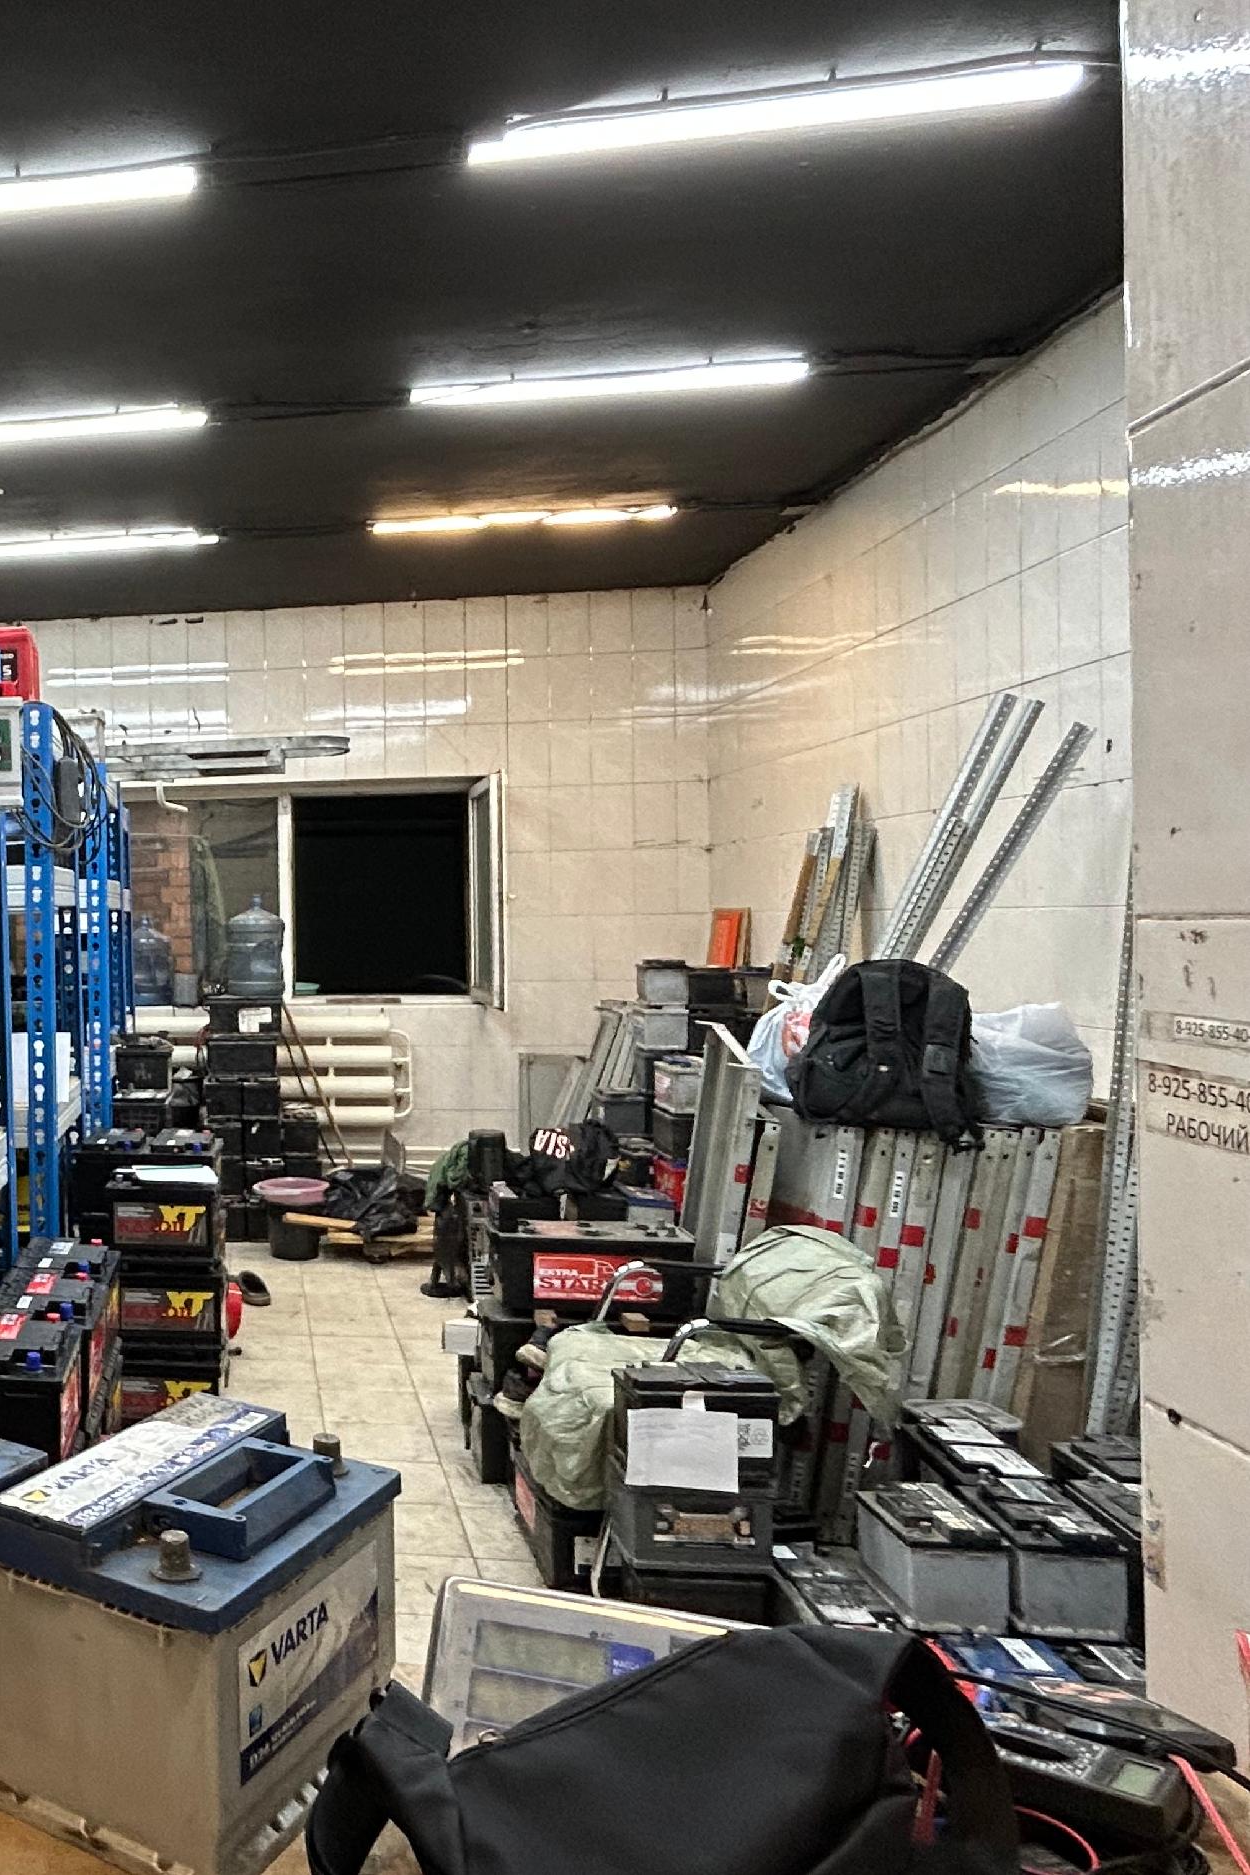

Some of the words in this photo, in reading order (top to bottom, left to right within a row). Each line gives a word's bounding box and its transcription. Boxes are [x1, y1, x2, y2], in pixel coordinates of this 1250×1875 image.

[534, 1129, 574, 1159] SIA
[1166, 1112, 1249, 1154] РАБОЧИЙ
[538, 1268, 579, 1276] EXTRA
[538, 1277, 607, 1289] STAR
[270, 1601, 329, 1665] VARTA
